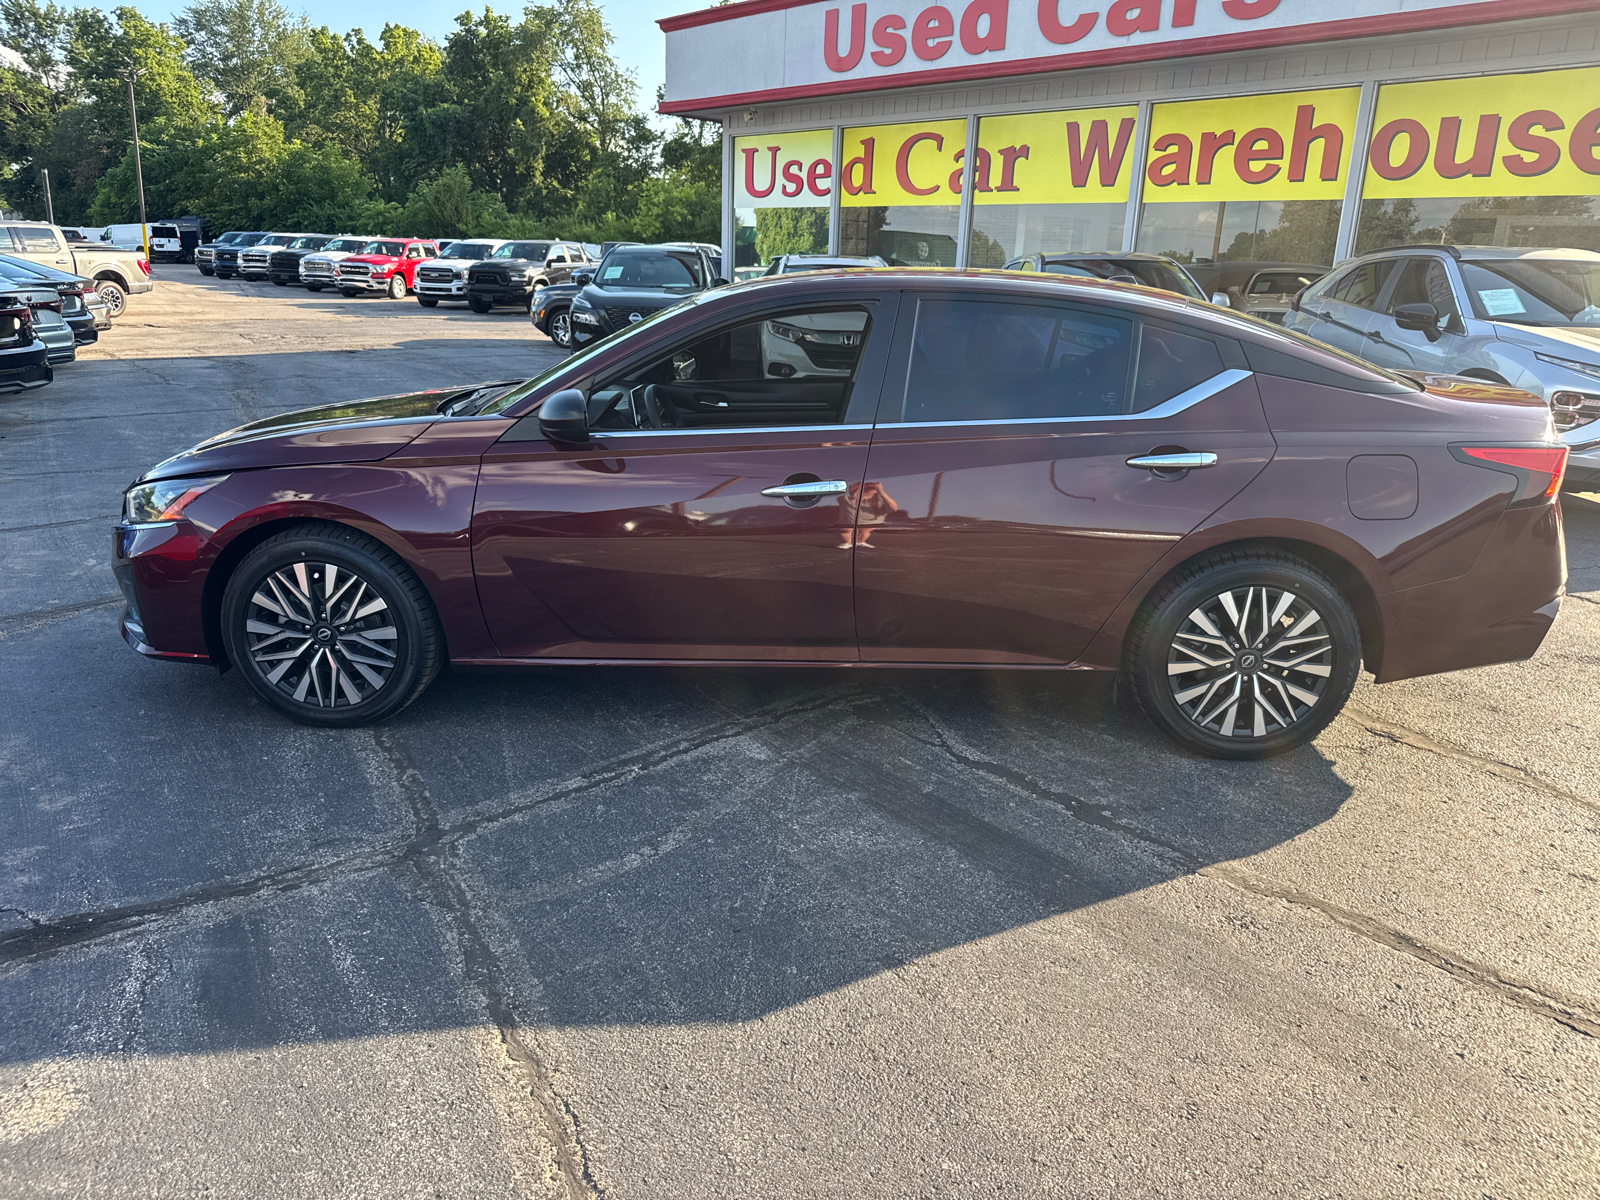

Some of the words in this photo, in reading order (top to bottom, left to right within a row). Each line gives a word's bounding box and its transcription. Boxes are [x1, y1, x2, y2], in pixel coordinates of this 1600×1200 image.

[823, 0, 1008, 73] Used
[741, 137, 876, 198] Used
[895, 132, 1029, 196] Car
